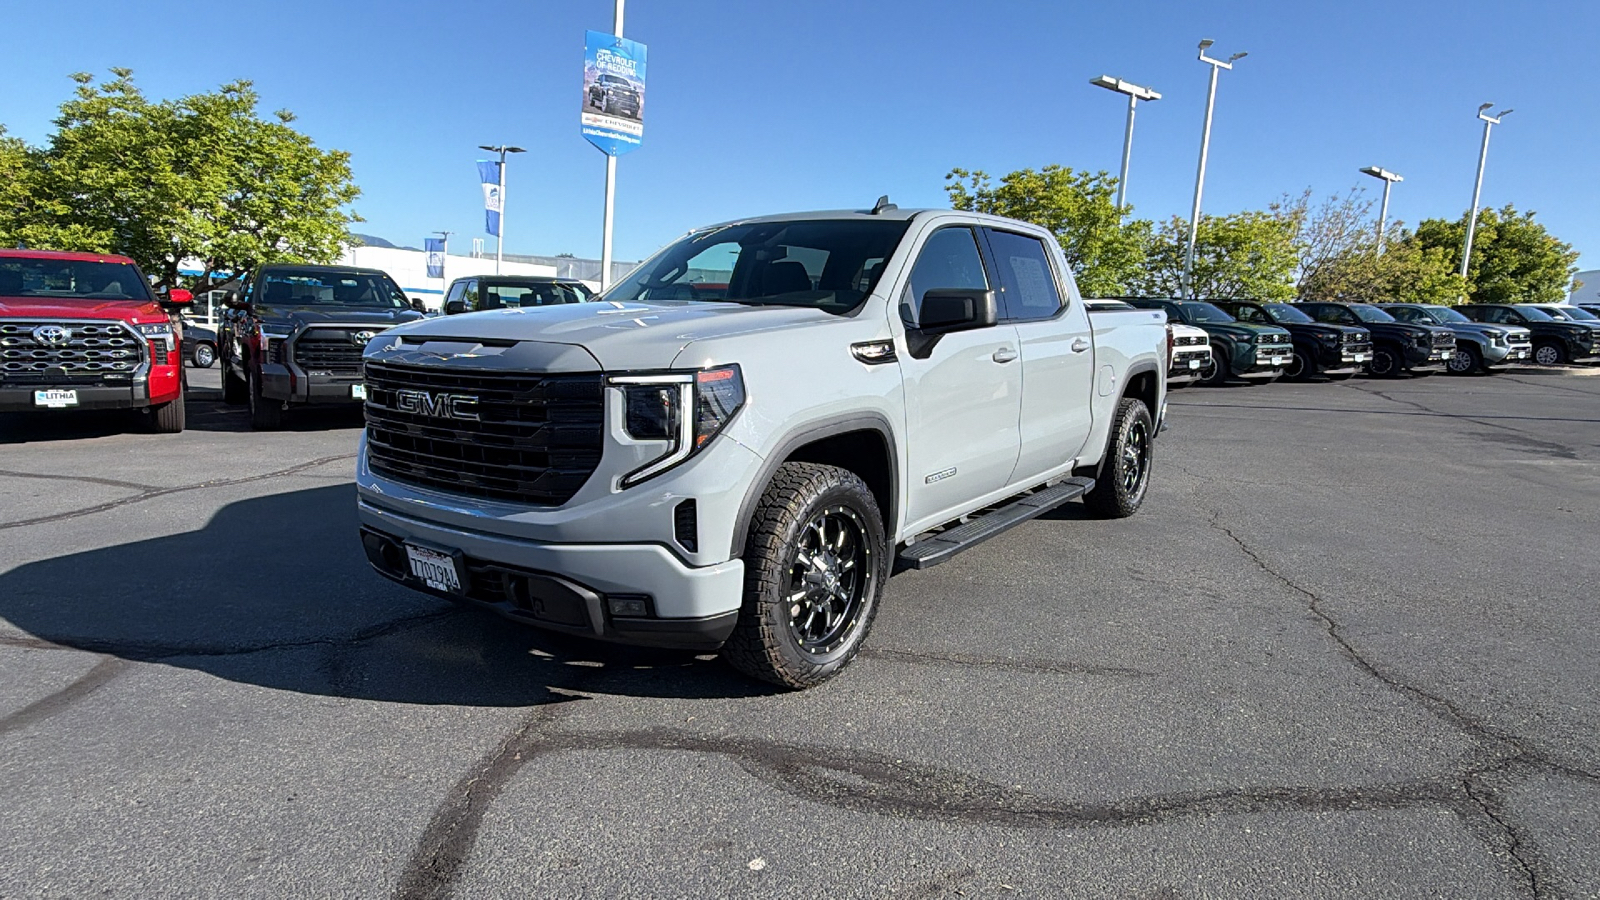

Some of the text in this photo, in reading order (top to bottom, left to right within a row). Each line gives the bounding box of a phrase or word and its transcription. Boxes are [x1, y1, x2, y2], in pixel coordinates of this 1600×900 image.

[596, 53, 637, 68] CHEVROLET
[596, 60, 637, 77] OF REDDING
[604, 119, 640, 131] CHEVROLET
[46, 392, 74, 400] LITHIA
[396, 388, 481, 422] GMC
